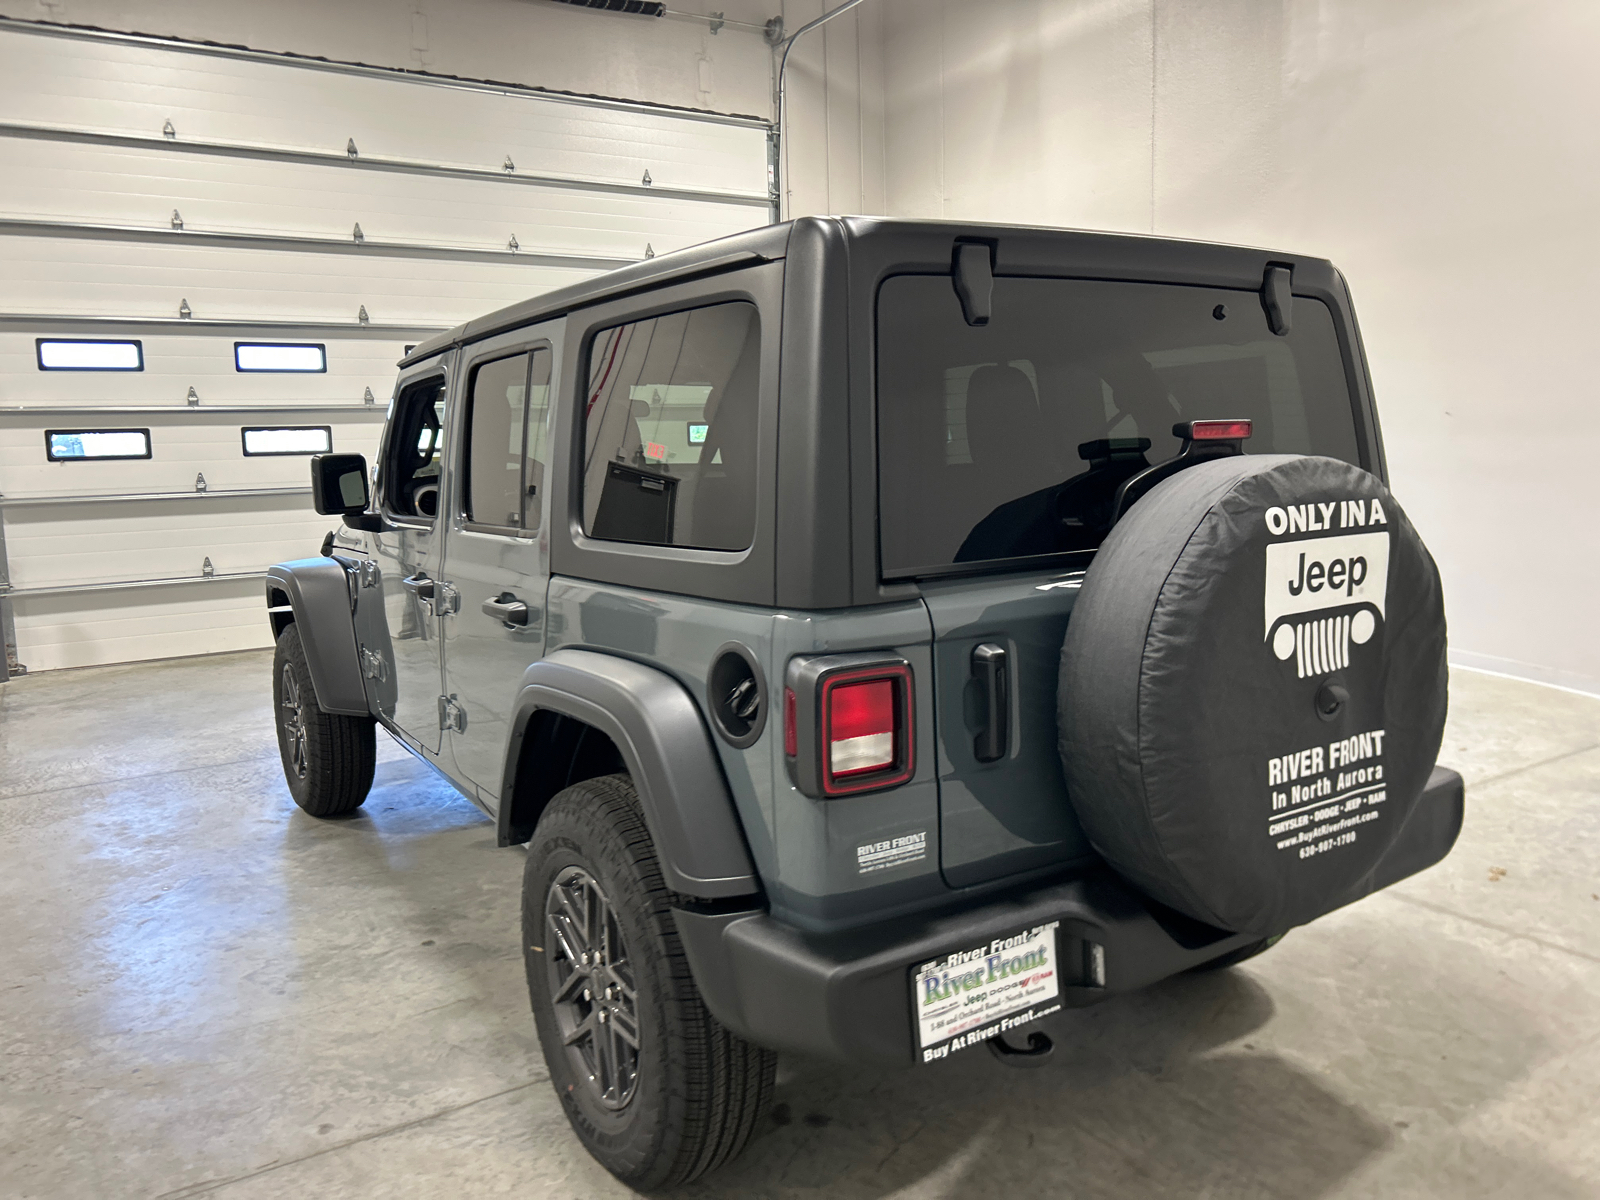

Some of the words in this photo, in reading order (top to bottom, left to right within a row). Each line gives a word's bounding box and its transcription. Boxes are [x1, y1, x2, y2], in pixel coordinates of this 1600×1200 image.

[1265, 502, 1336, 536] ONLY
[1340, 500, 1365, 528] IN
[1369, 498, 1387, 526] A
[1288, 552, 1368, 597] Jeep
[1268, 746, 1324, 786] RIVER
[1329, 730, 1385, 770] FRONT
[1272, 791, 1287, 810] In
[1291, 777, 1331, 804] North
[1336, 765, 1383, 791] Aurora
[1268, 815, 1309, 836] CHRYSLER
[1314, 805, 1340, 822] DODGE
[1344, 797, 1362, 813] JEEP
[1367, 790, 1386, 805] RAM
[857, 841, 891, 856] RIVER
[892, 832, 927, 848] FRONT
[947, 945, 988, 968] River
[991, 930, 1029, 954] Front
[963, 991, 988, 1006] Jeep
[923, 1044, 949, 1062] Buy
[951, 1037, 966, 1051] At
[967, 1023, 1000, 1045] River
